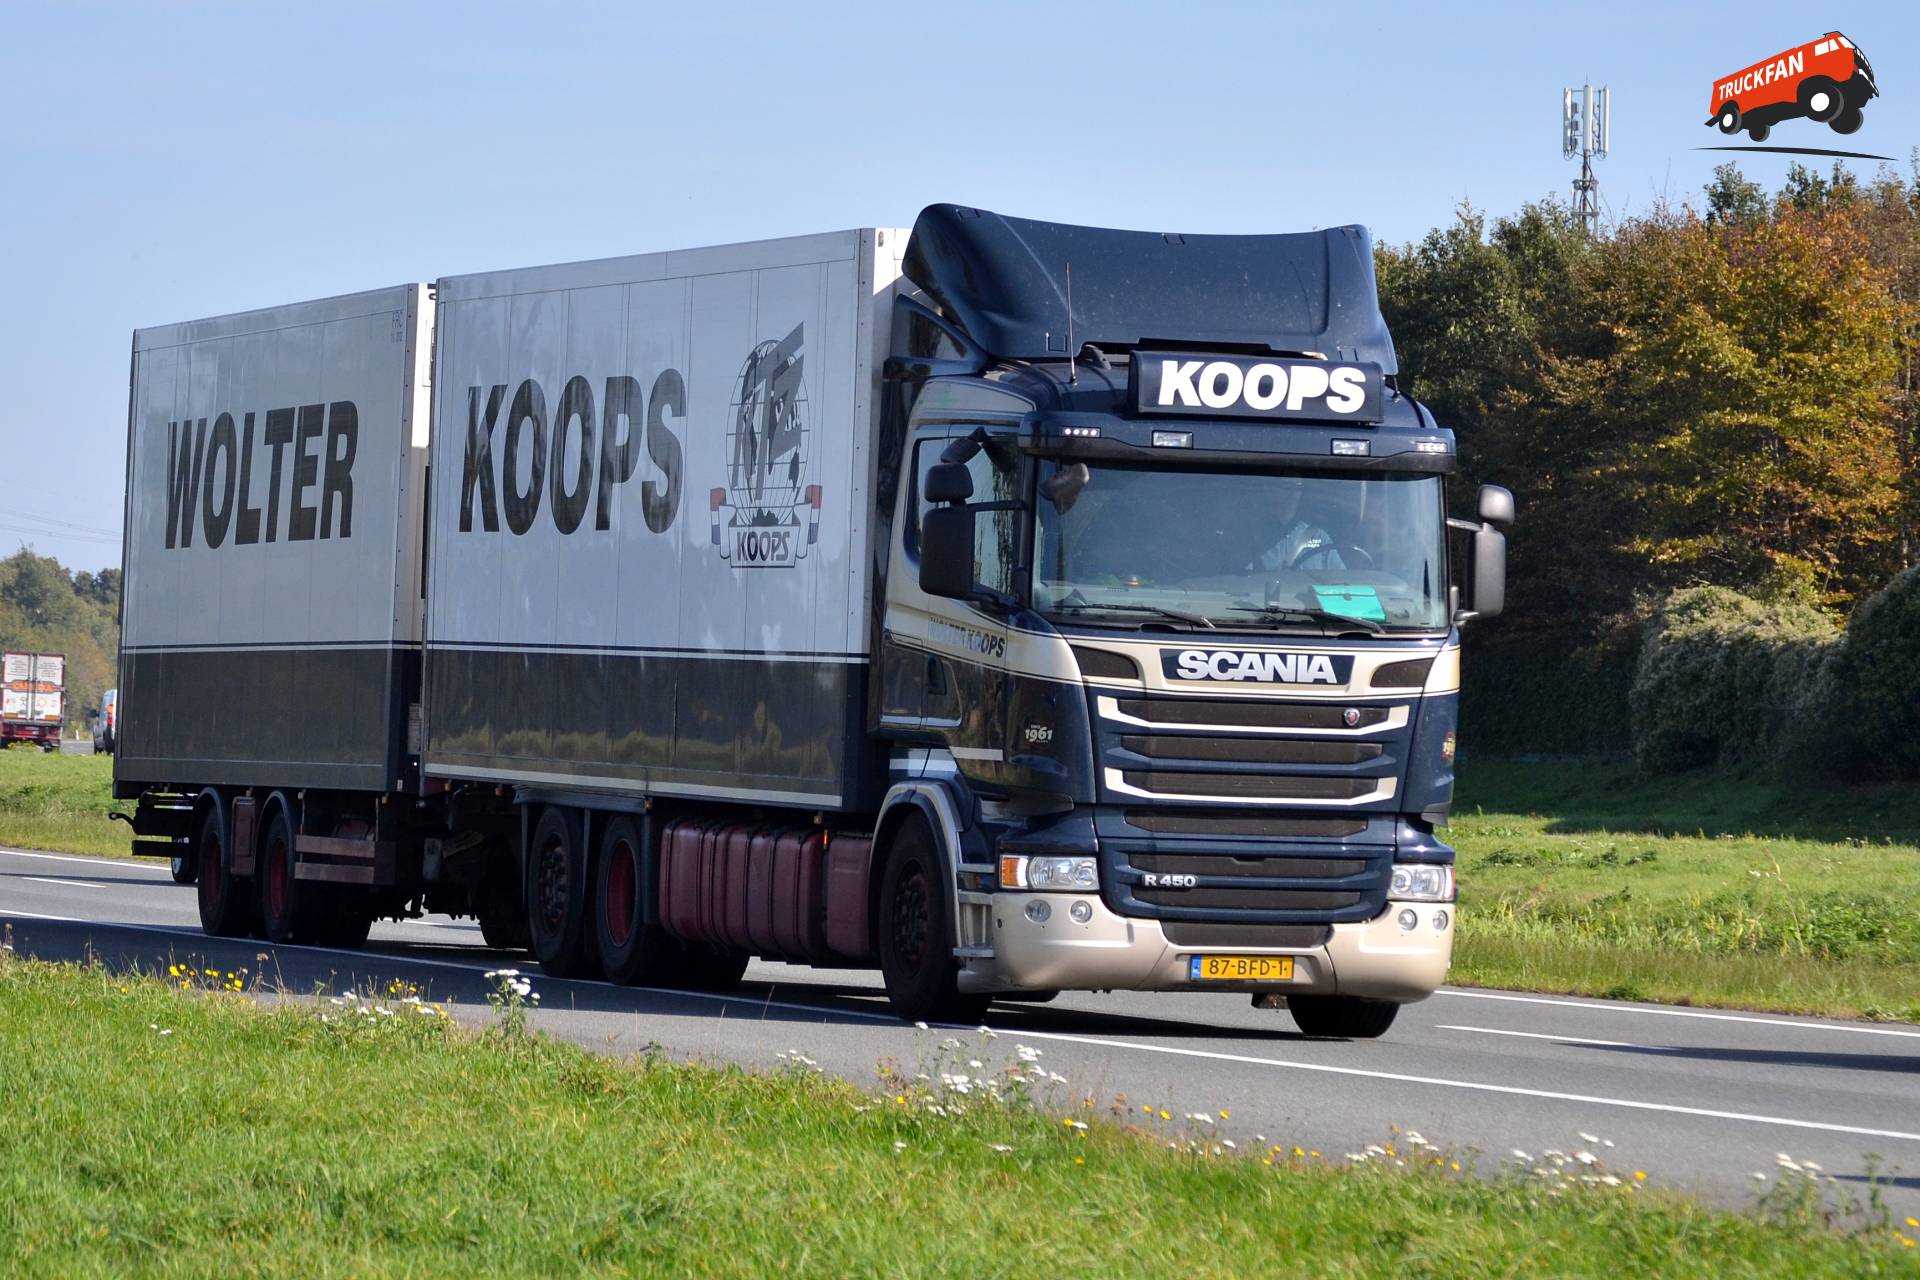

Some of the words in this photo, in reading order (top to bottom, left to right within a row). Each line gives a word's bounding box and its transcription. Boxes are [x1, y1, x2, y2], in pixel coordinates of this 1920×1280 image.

[1158, 360, 1367, 414] KOOPS
[458, 367, 687, 536] KOOPS
[164, 400, 359, 549] WOLTER
[736, 531, 791, 561] KOOPS
[966, 628, 1006, 658] KOOPS
[1176, 650, 1338, 684] SCANIA
[1025, 726, 1053, 743] 1961
[1144, 874, 1157, 887] R
[1159, 874, 1196, 887] 450
[1208, 959, 1283, 976] 87-BFD-1
